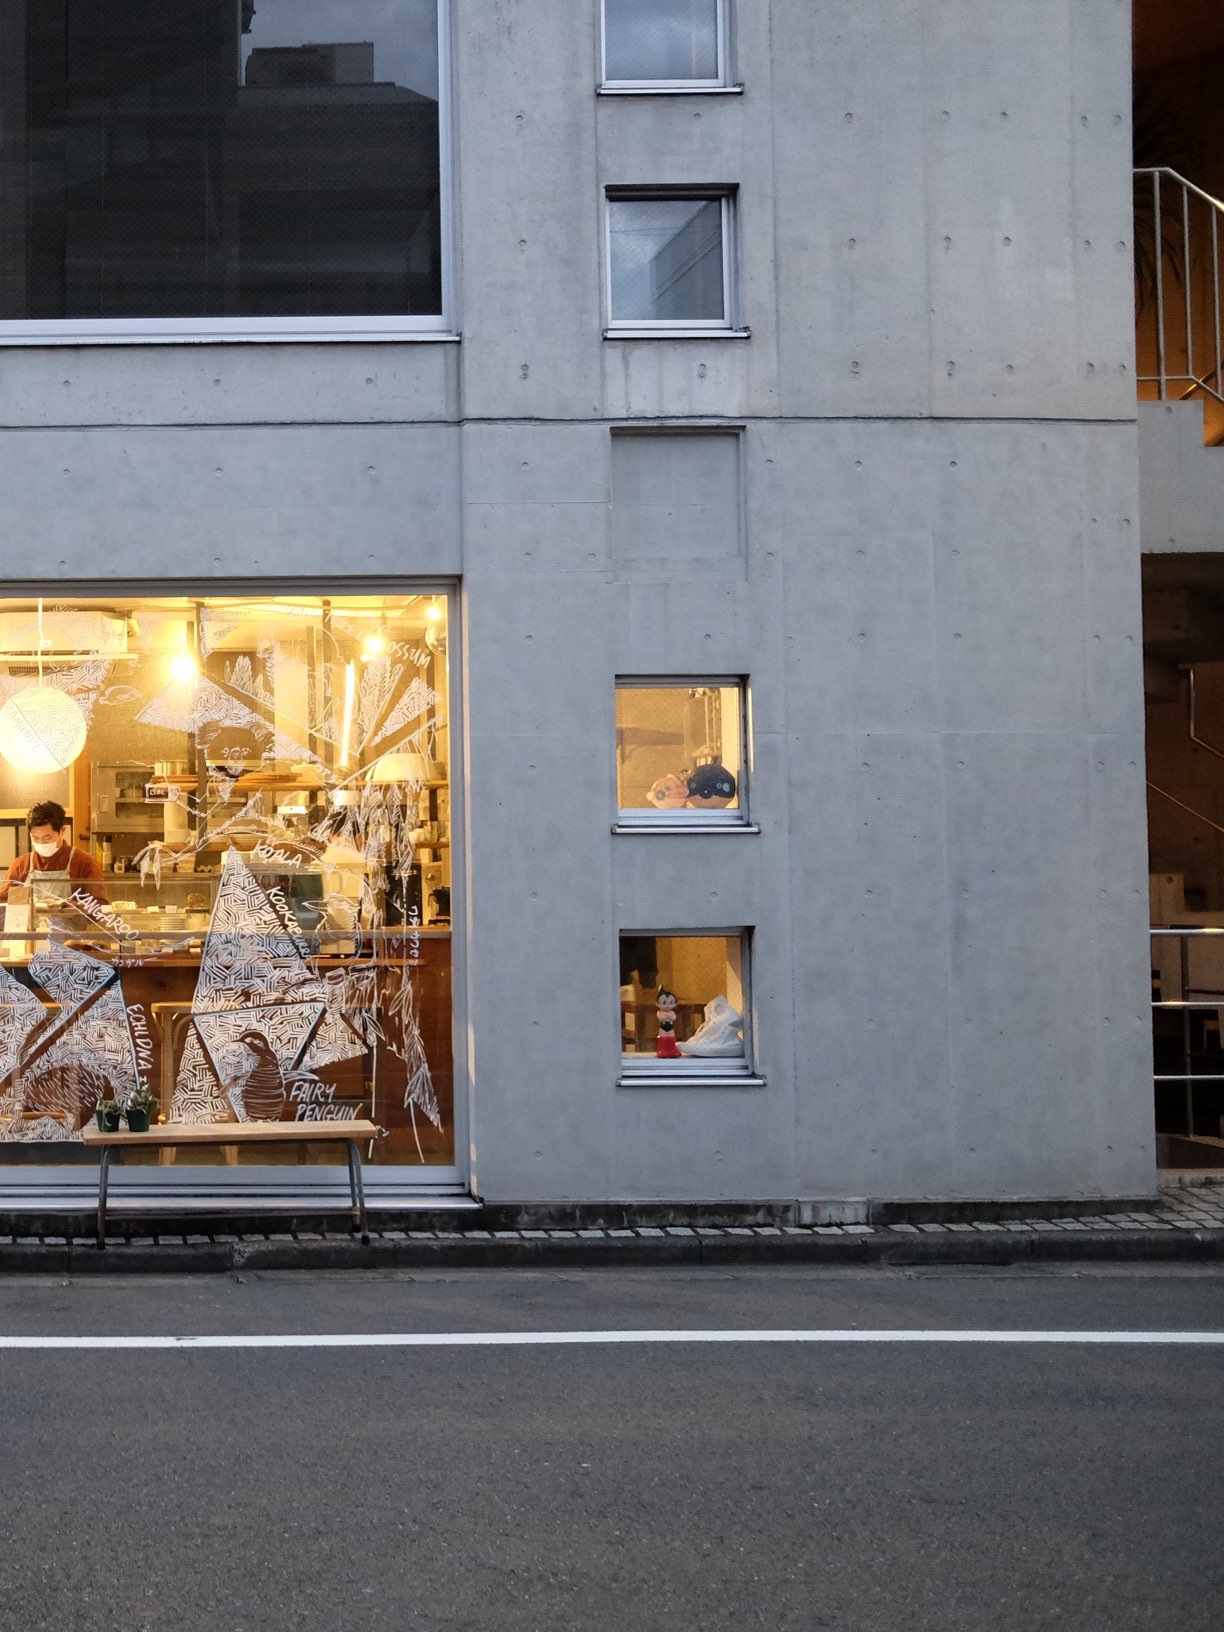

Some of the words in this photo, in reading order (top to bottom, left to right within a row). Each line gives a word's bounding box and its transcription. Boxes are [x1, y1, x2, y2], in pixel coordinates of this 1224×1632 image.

[385, 640, 432, 669] OSSUM
[253, 840, 302, 868] KOALA
[69, 887, 139, 940] KANGAROO
[266, 886, 312, 959] KOOKABURRA
[126, 1003, 154, 1070] ECHIDNA
[289, 1081, 337, 1103] FAIRY
[295, 1102, 363, 1121] PENGUIN
